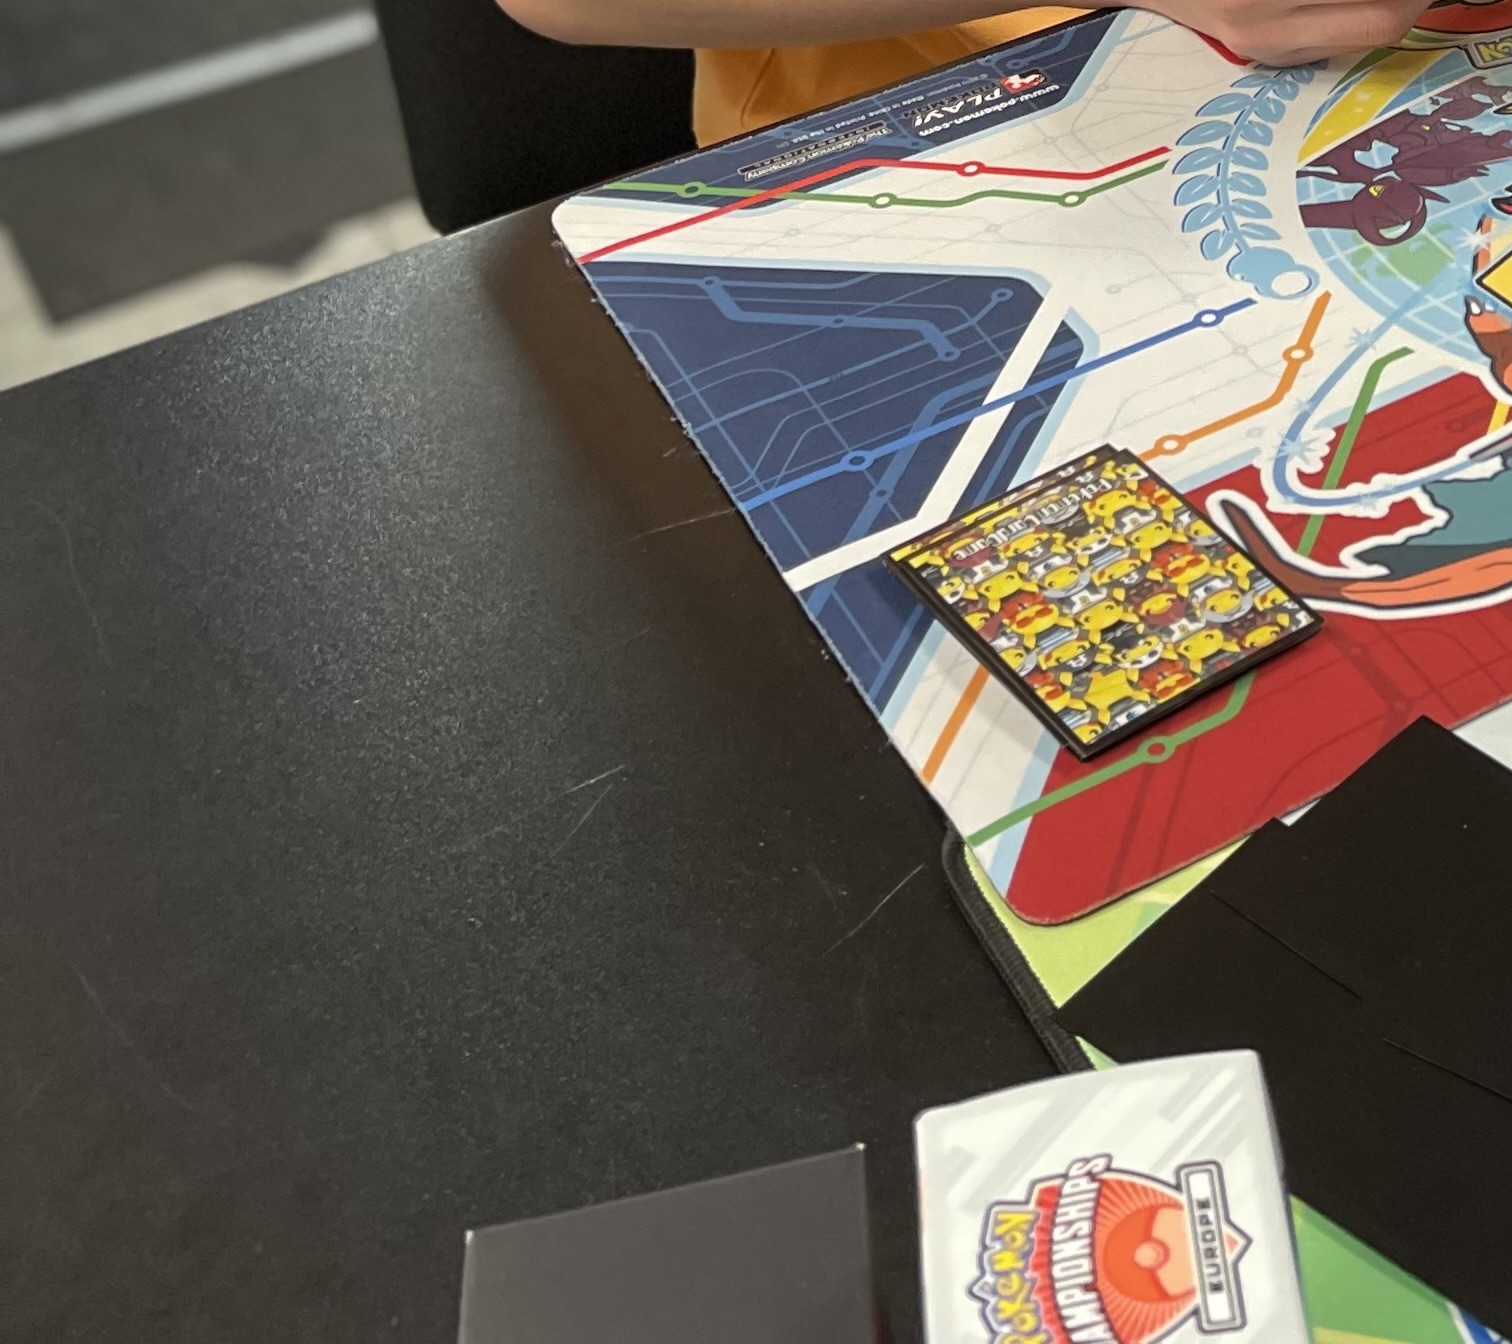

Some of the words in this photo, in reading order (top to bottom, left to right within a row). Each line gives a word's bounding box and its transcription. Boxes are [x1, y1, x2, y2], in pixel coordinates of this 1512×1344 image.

[912, 87, 1002, 128] PLAY!
[918, 84, 1060, 137] www.pokemon.com
[1052, 1155, 1116, 1344] AMPIONSHIPS
[1197, 1198, 1224, 1293] EUROPE
